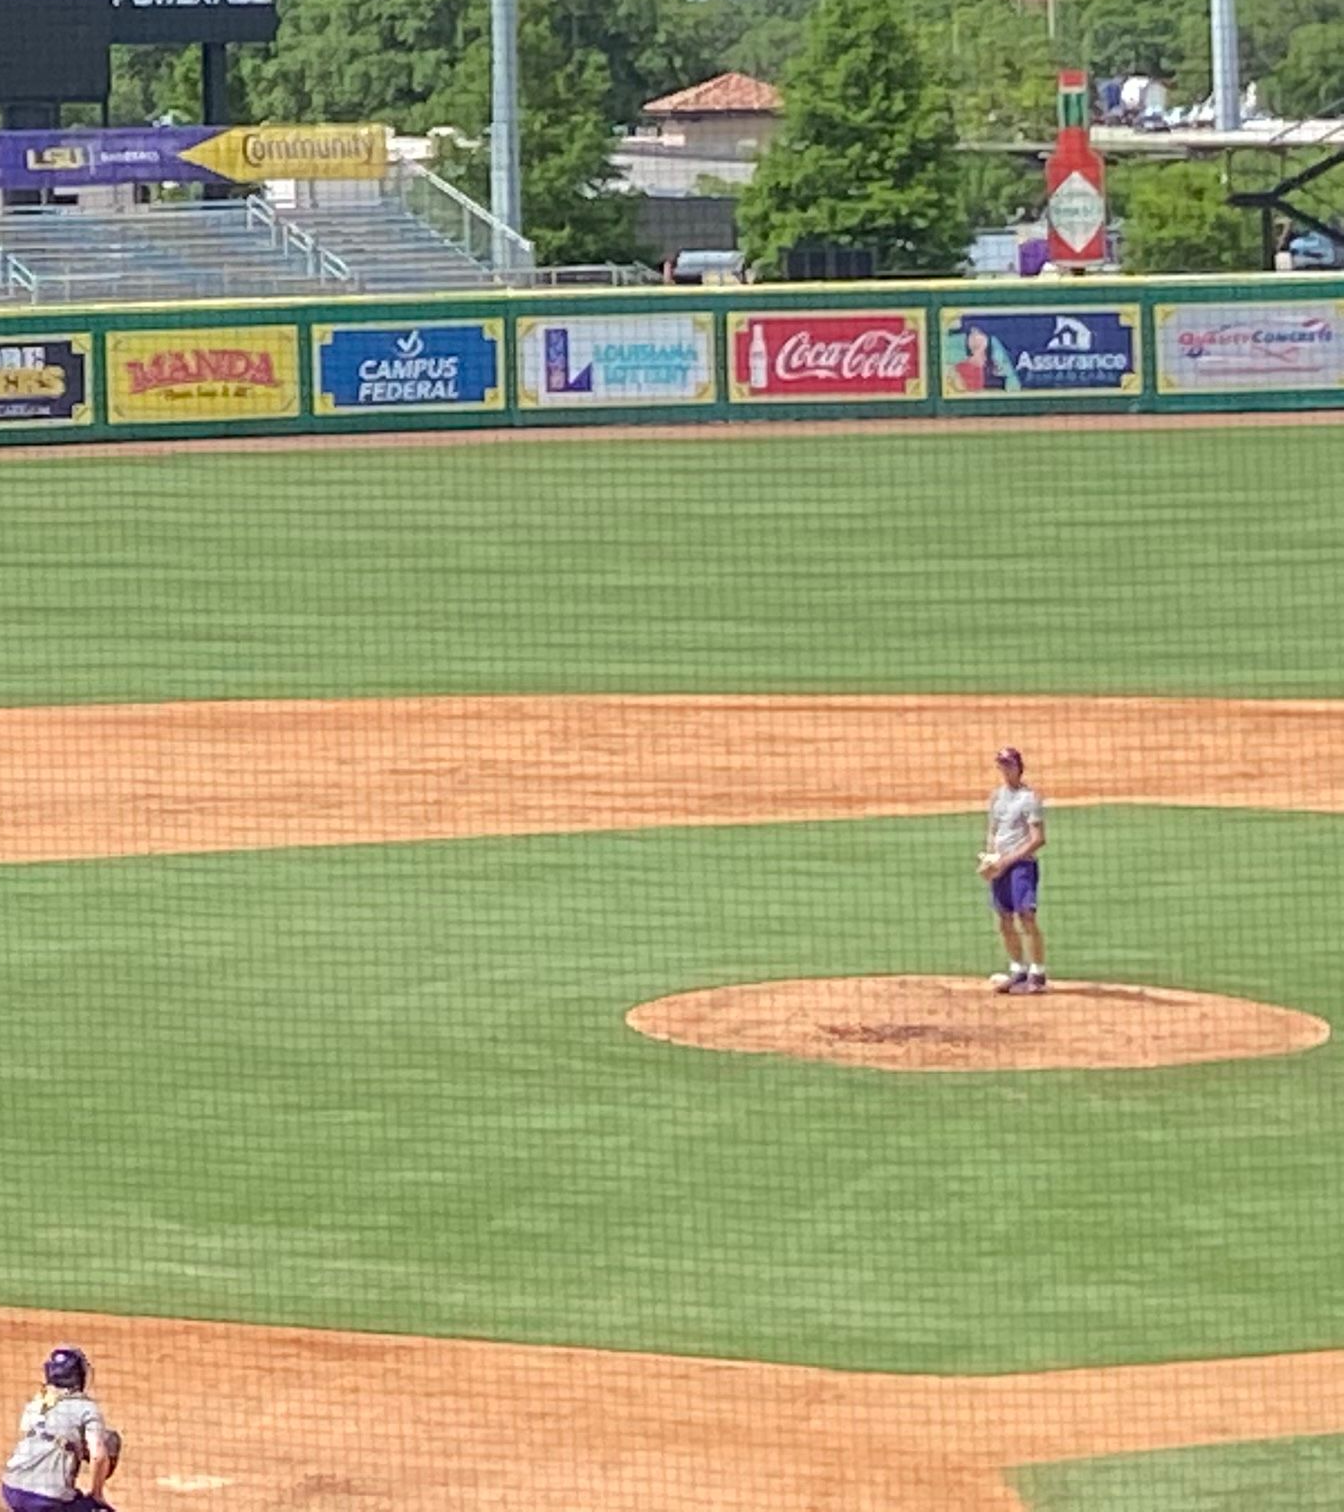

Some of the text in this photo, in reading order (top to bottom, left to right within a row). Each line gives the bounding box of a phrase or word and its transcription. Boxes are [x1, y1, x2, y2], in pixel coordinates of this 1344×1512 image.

[26, 147, 84, 170] LSU
[242, 133, 373, 168] Community
[775, 329, 916, 381] Coca-Cola
[1015, 351, 1127, 372] Assurance
[126, 349, 276, 394] MANDA
[358, 356, 459, 381] CAMPUS
[358, 379, 459, 404] FEDERAL
